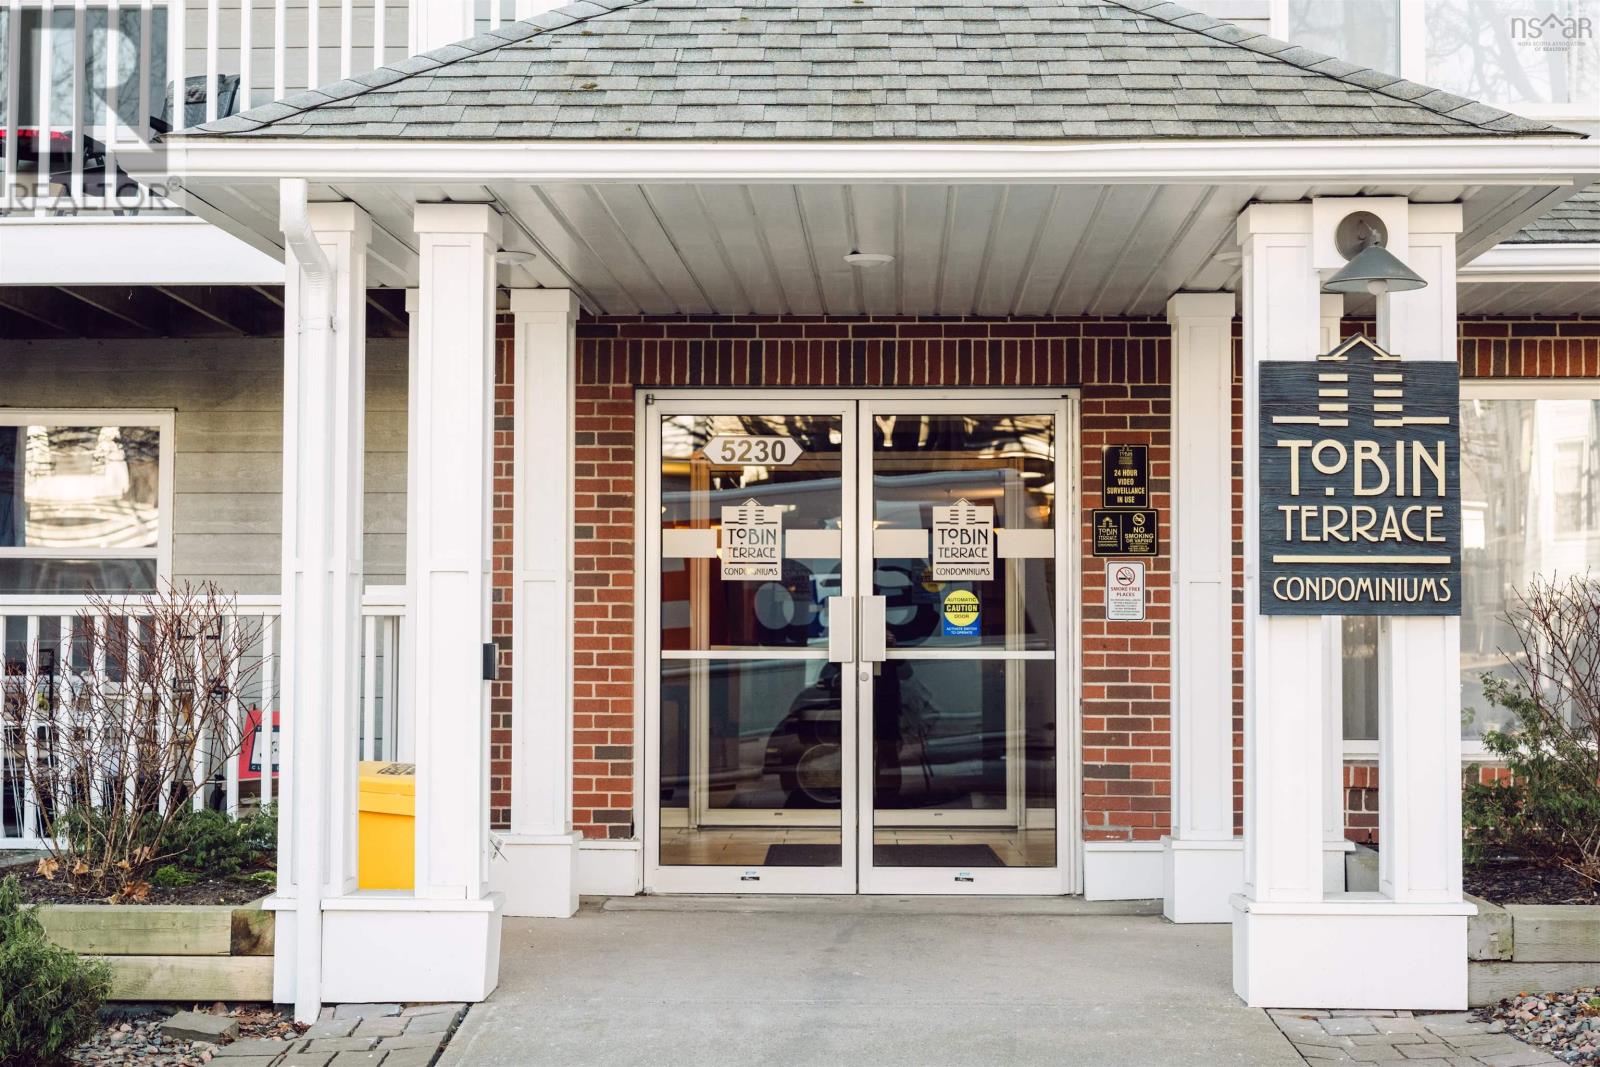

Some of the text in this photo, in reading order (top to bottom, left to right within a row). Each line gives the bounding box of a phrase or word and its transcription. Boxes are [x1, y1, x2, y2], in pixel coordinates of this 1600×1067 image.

[720, 439, 786, 463] 5230
[1113, 469, 1121, 477] 24
[1277, 439, 1446, 497] TOBIN
[1106, 487, 1145, 495] SURVEILLANCE
[1277, 505, 1446, 543] TERRACE
[726, 528, 777, 545] TOBIN
[938, 528, 988, 545] TOBIN
[727, 546, 777, 558] TERRACE
[937, 546, 989, 559] TERRACE
[936, 567, 991, 576] CONDOMINIUMS
[1273, 576, 1452, 602] CONDOMINIUMS
[946, 604, 978, 612] CAUTION
